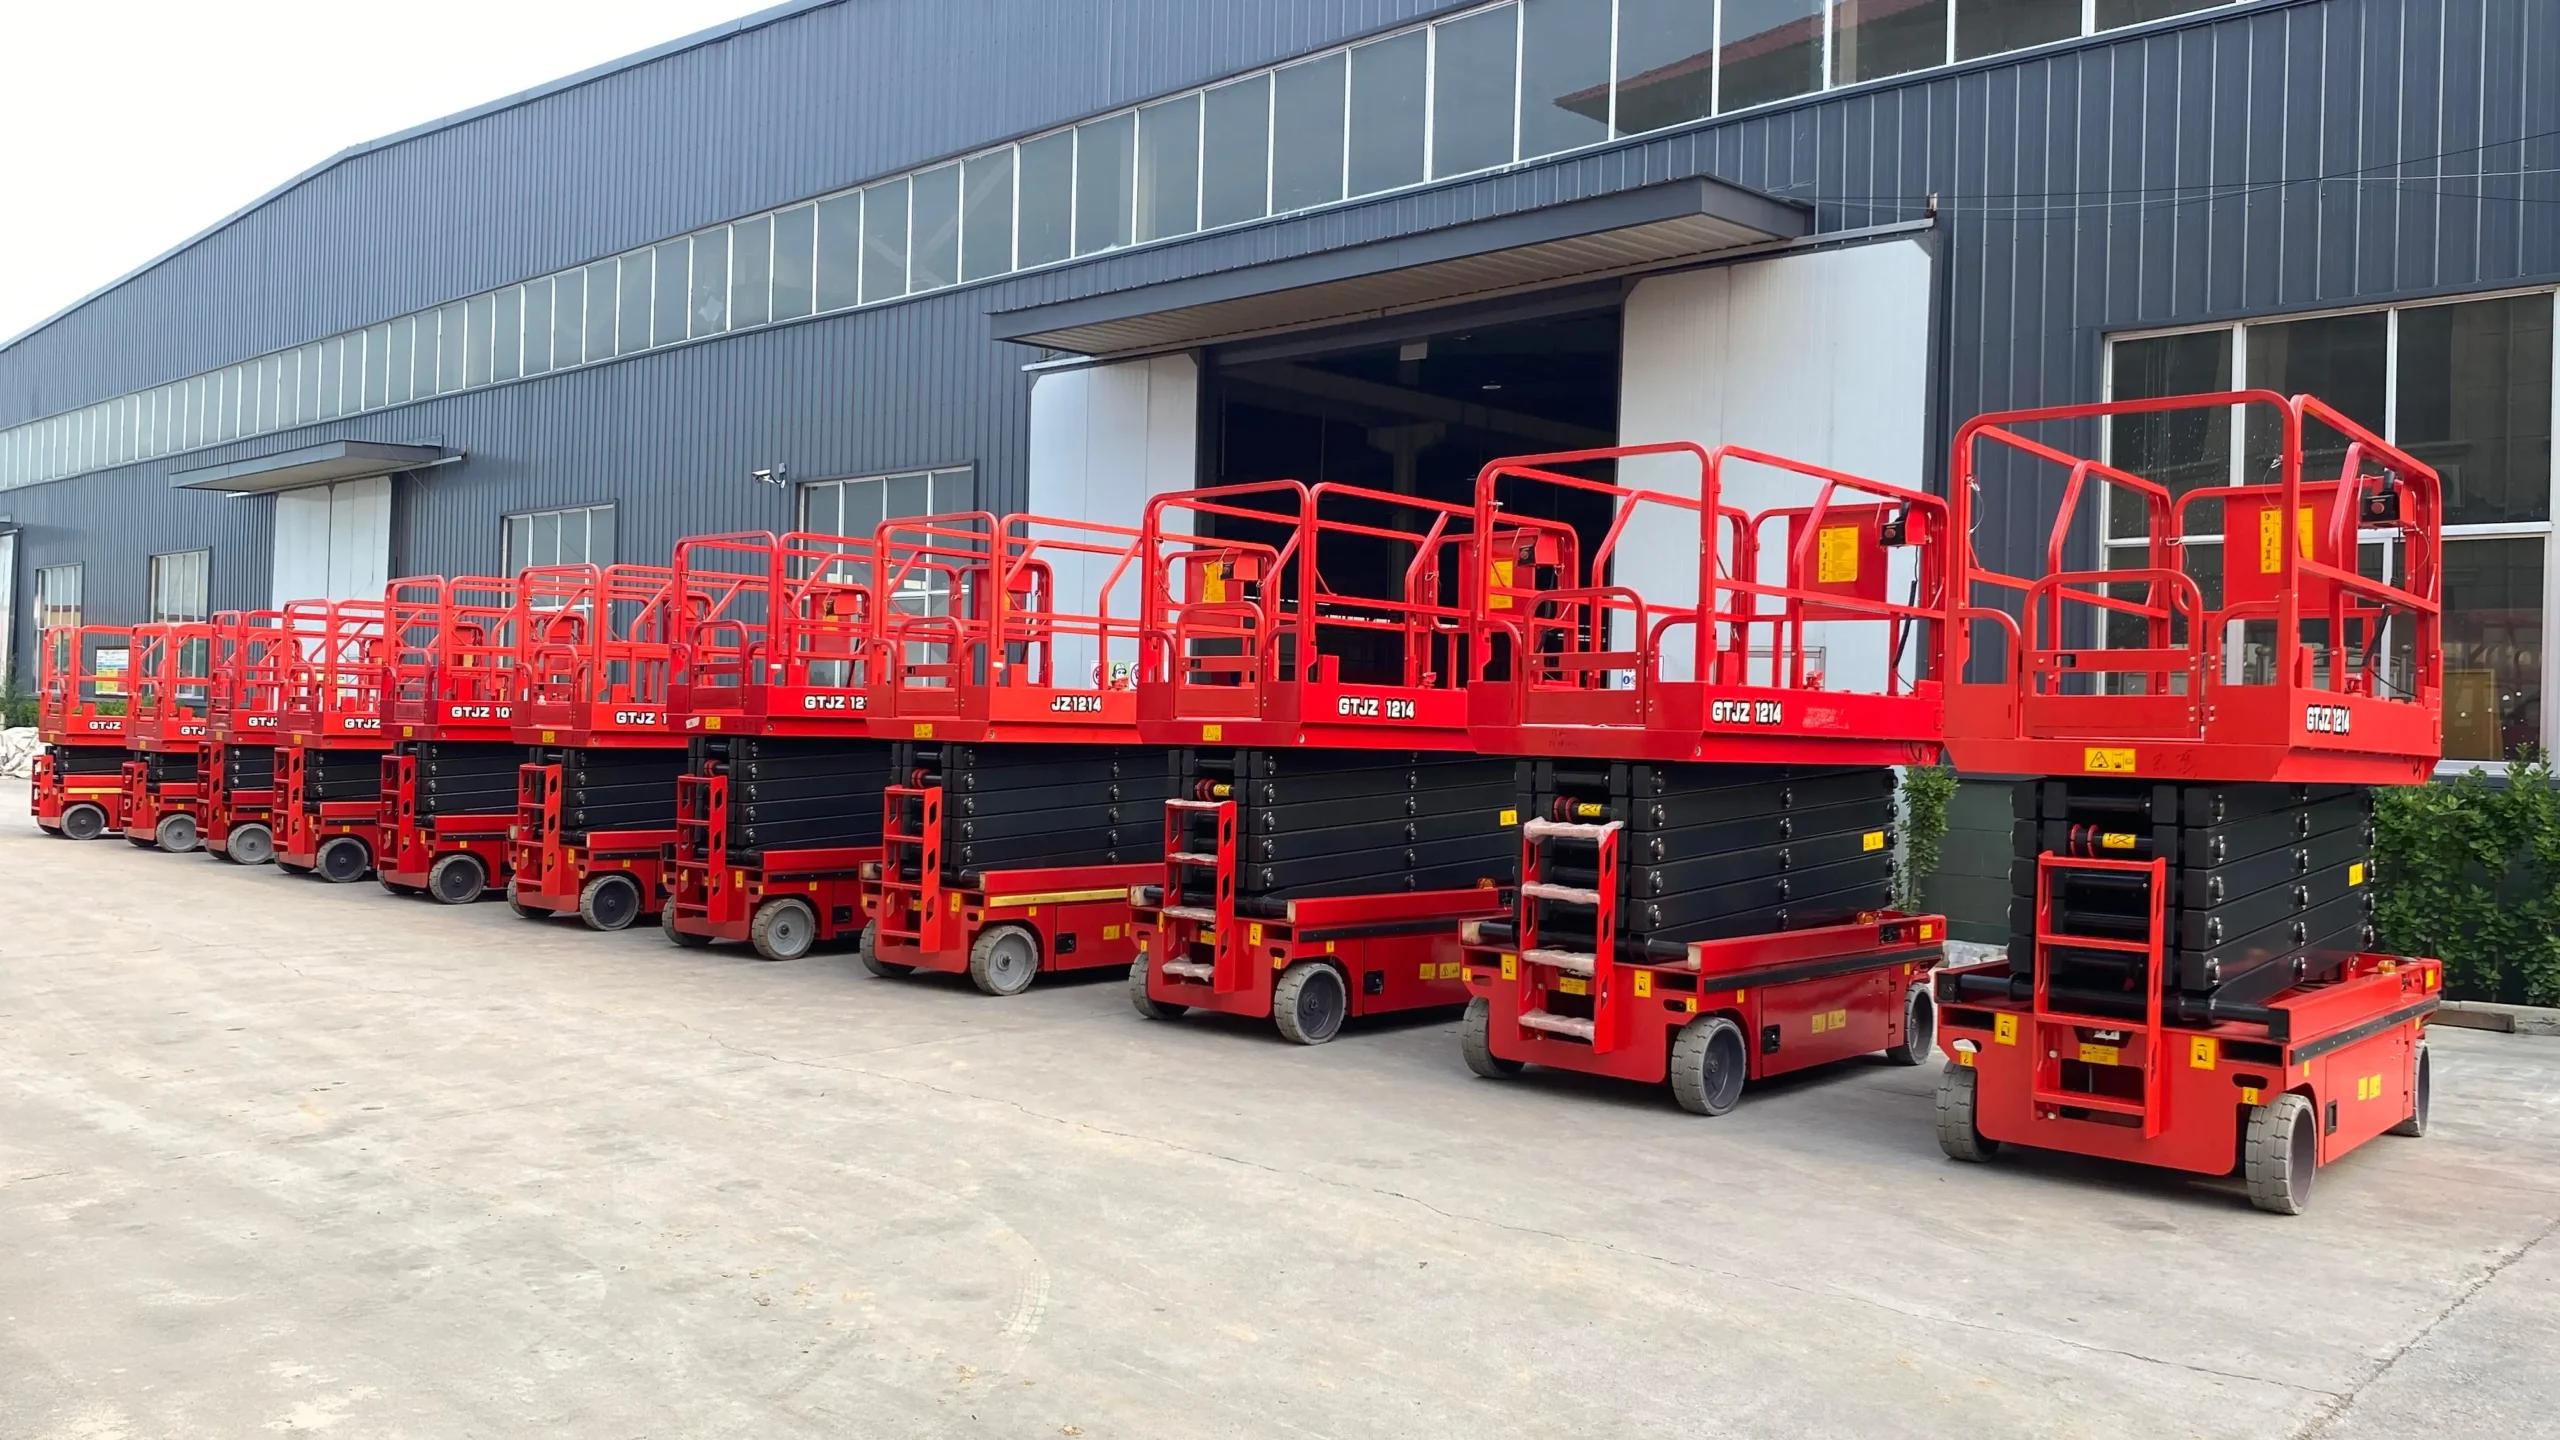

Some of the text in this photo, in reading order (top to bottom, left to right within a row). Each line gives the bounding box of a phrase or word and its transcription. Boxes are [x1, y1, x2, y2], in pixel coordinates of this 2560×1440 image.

[804, 695, 846, 710] GTJZ
[1337, 697, 1416, 719] GTJZ 1214
[450, 706, 513, 719] GTJZ 10
[615, 711, 656, 725] GTJZ
[1711, 700, 1783, 724] GTJZ 1214
[88, 721, 122, 730] GTJZ
[344, 718, 380, 729] GTJZ
[2305, 705, 2351, 735] GTJZ 1214
